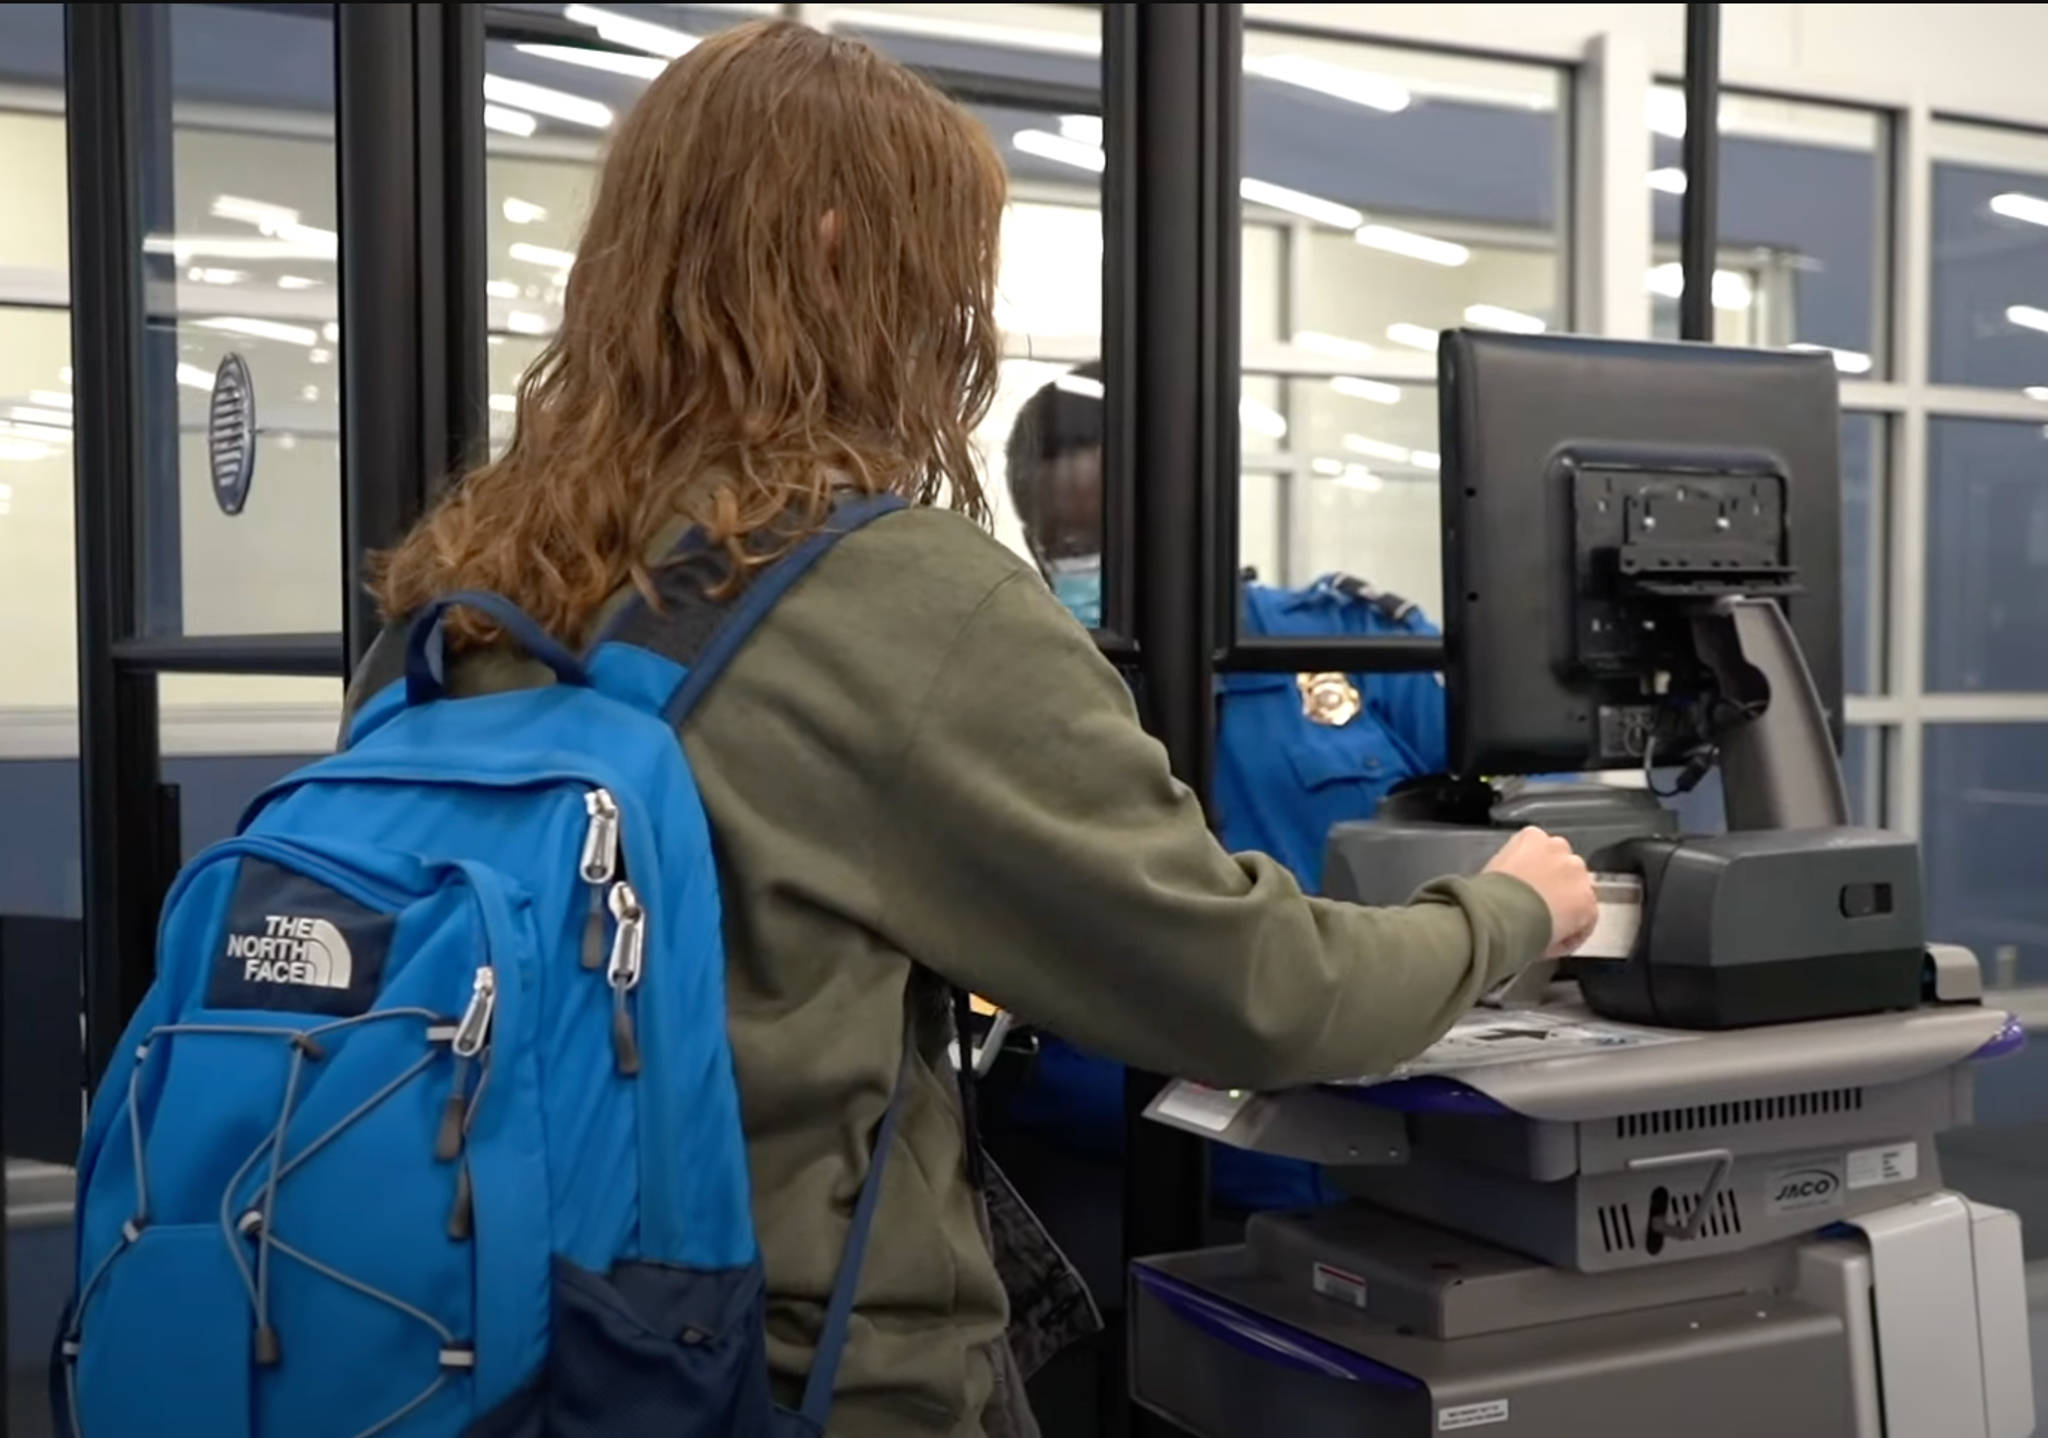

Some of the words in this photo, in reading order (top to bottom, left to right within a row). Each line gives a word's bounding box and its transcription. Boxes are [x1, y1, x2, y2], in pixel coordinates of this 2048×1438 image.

[265, 915, 314, 937] THE
[226, 934, 308, 961] NORTH
[243, 960, 306, 984] FACE
[1775, 1179, 1831, 1201] JACO
